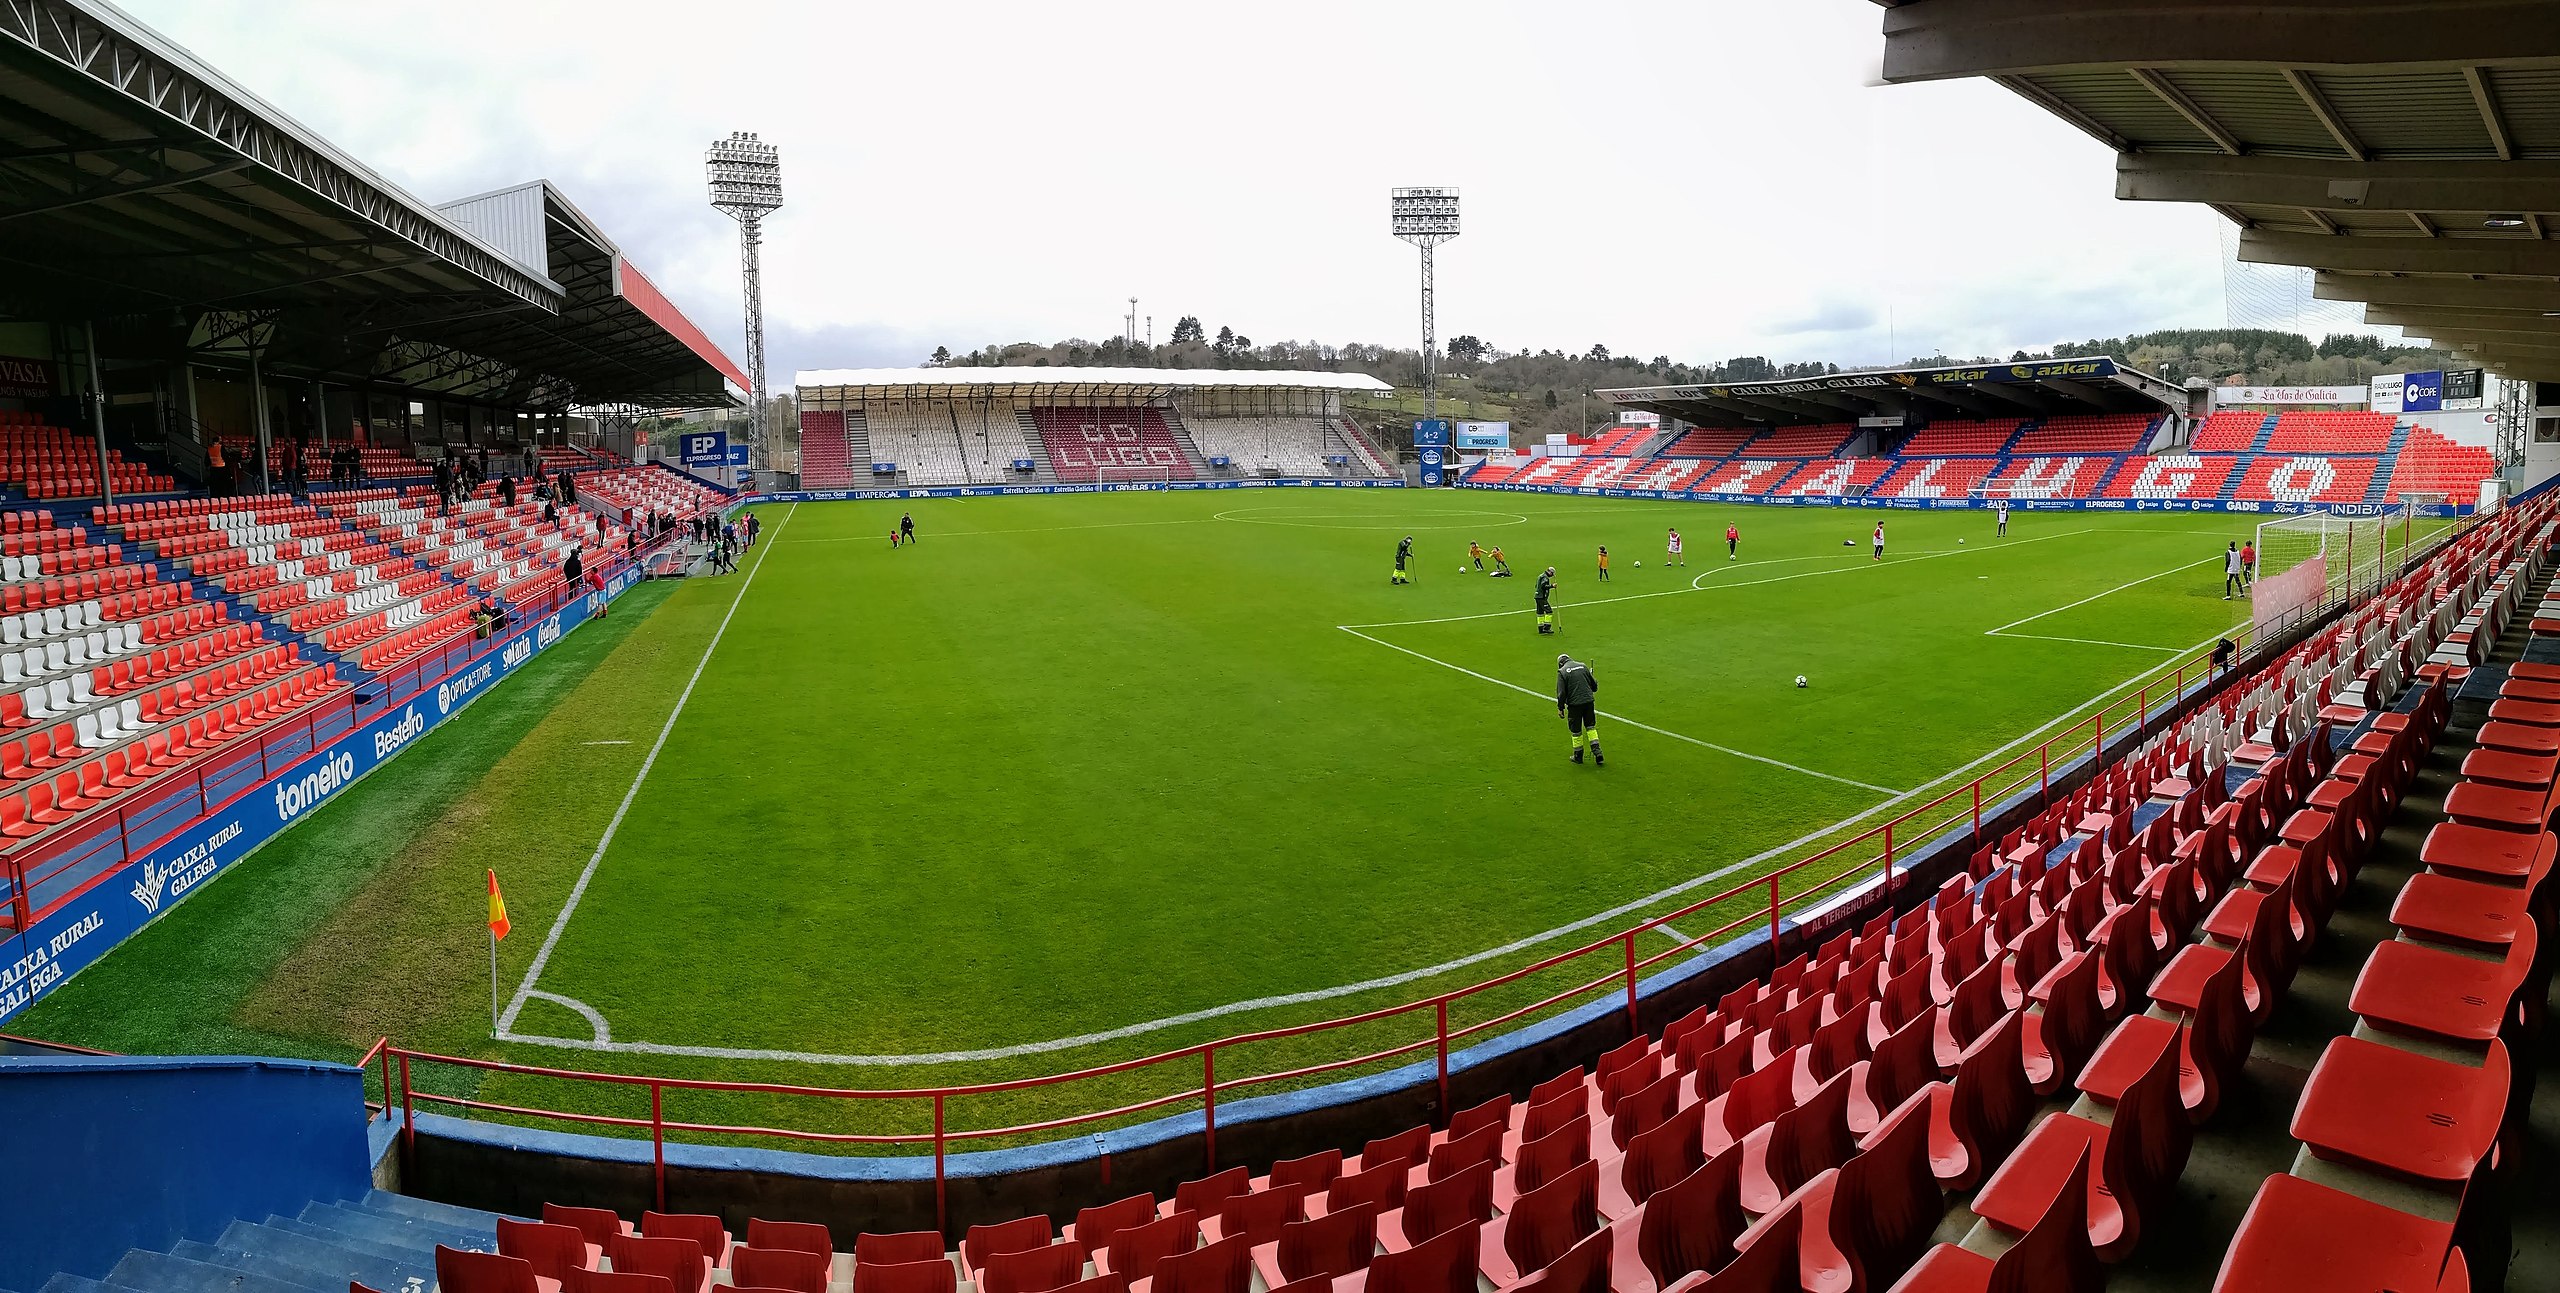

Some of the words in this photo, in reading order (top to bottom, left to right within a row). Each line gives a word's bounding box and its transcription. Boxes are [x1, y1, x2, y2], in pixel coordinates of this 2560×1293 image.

[0, 361, 48, 383] VASA
[1932, 369, 1989, 382] azkar
[2037, 363, 2100, 376] azkar
[1731, 387, 1775, 396] CAIXA
[1775, 382, 1827, 394] RURAL
[2260, 389, 2274, 400] La
[2294, 389, 2303, 400] de
[2305, 389, 2337, 400] Galicia
[2419, 387, 2437, 397] COPE
[692, 437, 716, 454] EP
[855, 491, 900, 499] LIMPERGAL
[2226, 501, 2260, 511] GADIS
[2272, 502, 2299, 514] Ford
[2331, 504, 2385, 515] INDIBA
[450, 677, 473, 702] ÓPTICA
[476, 661, 492, 685] TORRE
[375, 703, 424, 759] Besteiro
[275, 750, 353, 821] torneiro
[169, 842, 208, 878] CAIXA
[208, 820, 243, 853] RURAL
[170, 856, 217, 897] GALEGA
[1811, 919, 1823, 933] AL
[1824, 900, 1862, 926] TERRENO
[1863, 893, 1874, 905] DE
[1876, 875, 1901, 900] JUGO
[0, 946, 48, 992] AIXA
[49, 910, 104, 958] RURAL
